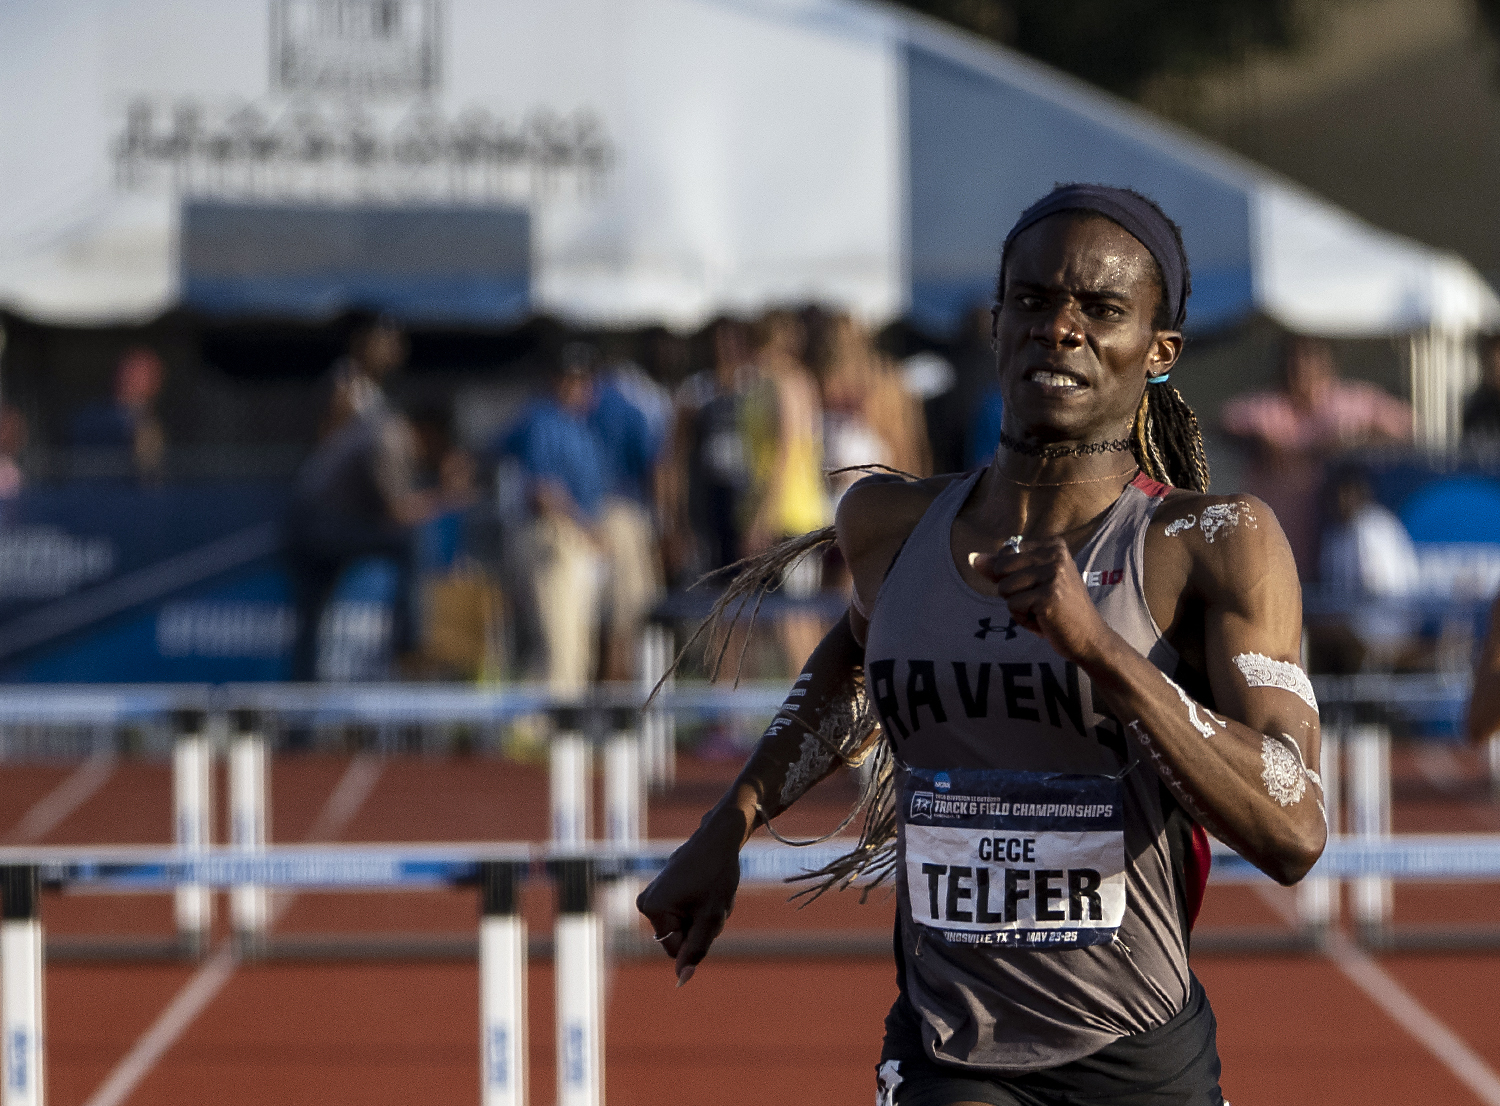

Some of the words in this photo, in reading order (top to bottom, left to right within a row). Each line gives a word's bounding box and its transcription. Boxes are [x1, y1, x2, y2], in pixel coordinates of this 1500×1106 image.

[934, 800, 968, 814] TRACK
[969, 802, 978, 815] &
[980, 803, 1010, 816] FIELD
[1012, 803, 1113, 818] CHAMPIONSHIPS
[978, 837, 1036, 863] CECE
[921, 862, 1103, 924] TELFER
[995, 932, 1009, 943] TX
[1026, 931, 1048, 942] MAY
